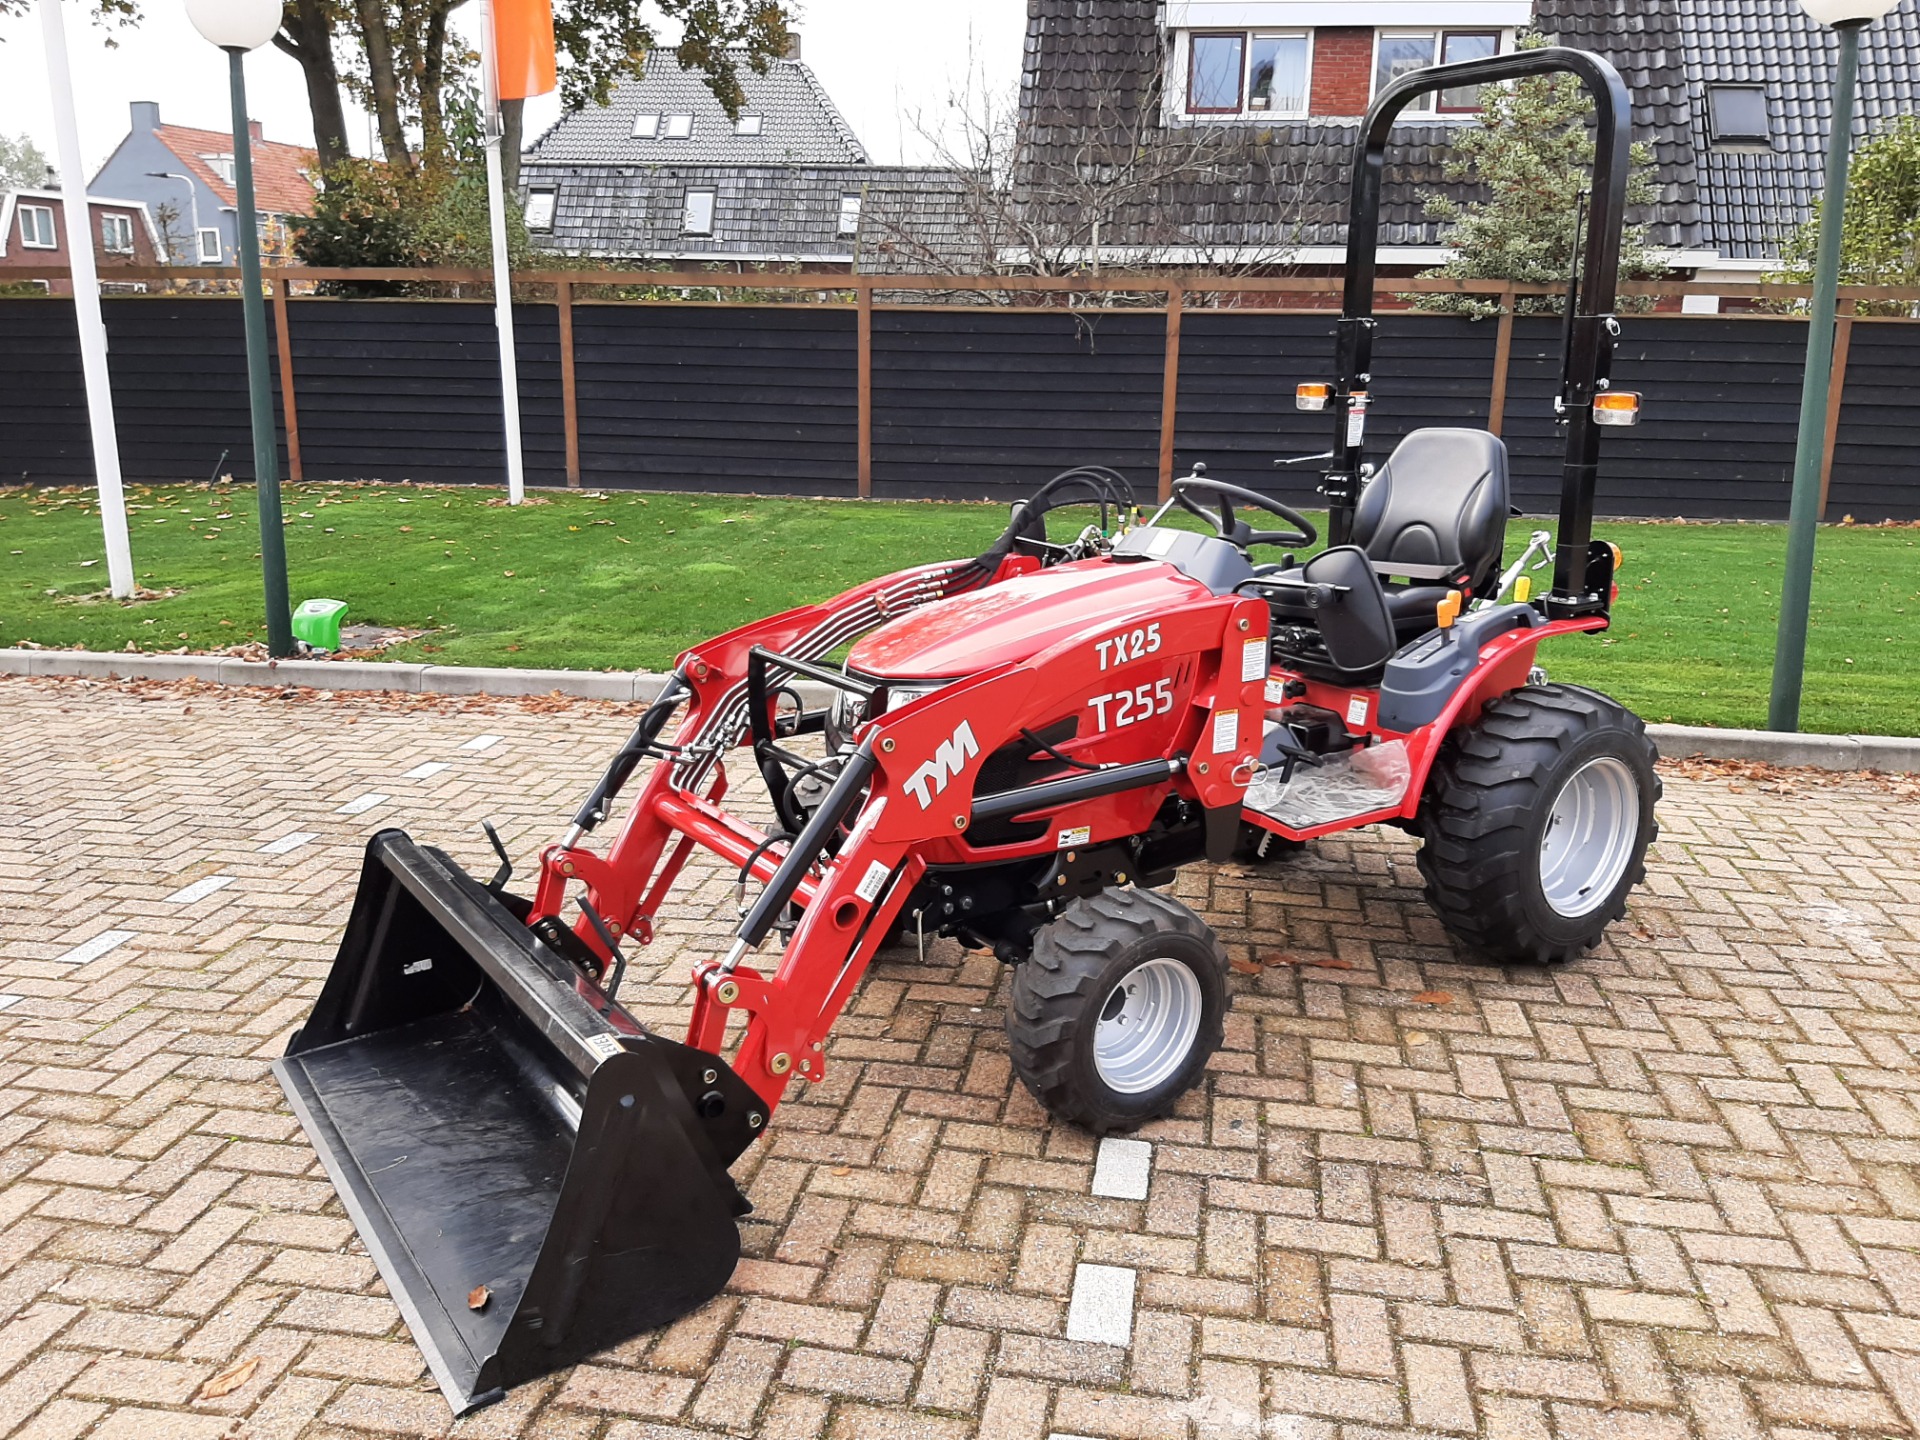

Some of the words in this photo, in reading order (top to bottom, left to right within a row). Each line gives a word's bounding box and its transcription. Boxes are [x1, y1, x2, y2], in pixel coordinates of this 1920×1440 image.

[1095, 622, 1161, 671] TX25
[1088, 677, 1173, 732] T255
[902, 719, 980, 811] TYM
